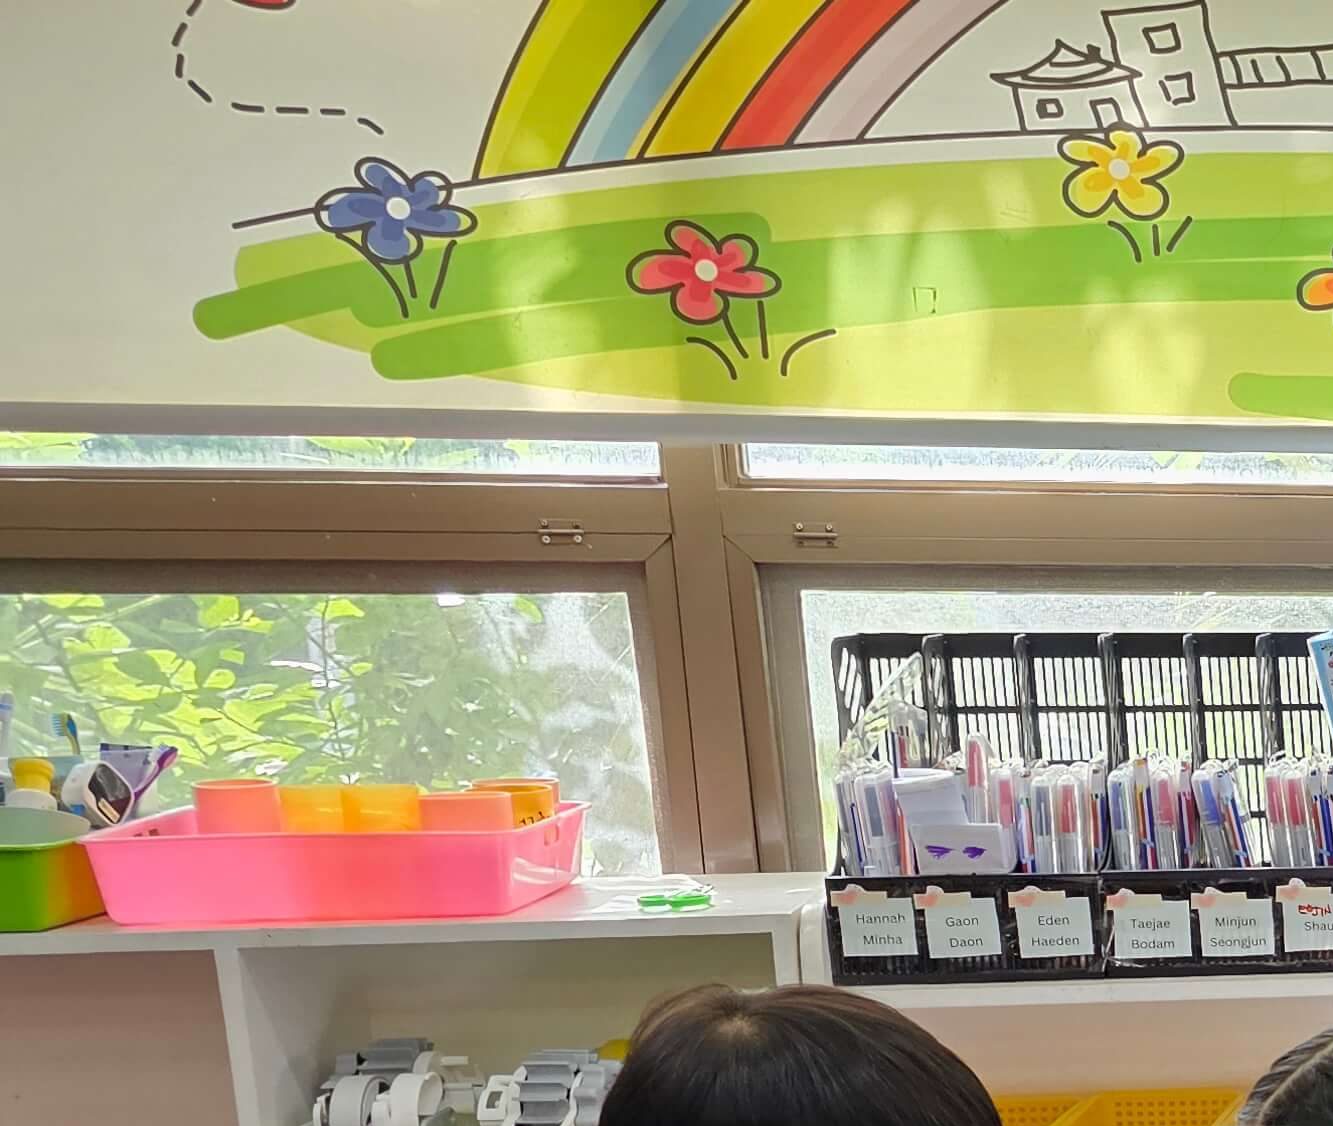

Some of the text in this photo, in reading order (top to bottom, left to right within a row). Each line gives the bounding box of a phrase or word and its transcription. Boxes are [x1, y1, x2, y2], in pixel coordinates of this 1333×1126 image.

[856, 914, 905, 924] Hannah
[945, 916, 979, 927] Gaon
[1038, 915, 1070, 926] Eden
[1215, 917, 1257, 928] Minjun
[1130, 919, 1171, 931] Taejae
[863, 935, 903, 945] Minha
[950, 937, 984, 948] Daon
[1031, 936, 1080, 947] Haeden
[1131, 939, 1175, 949] Bodam
[1210, 936, 1267, 949] Seongjun
